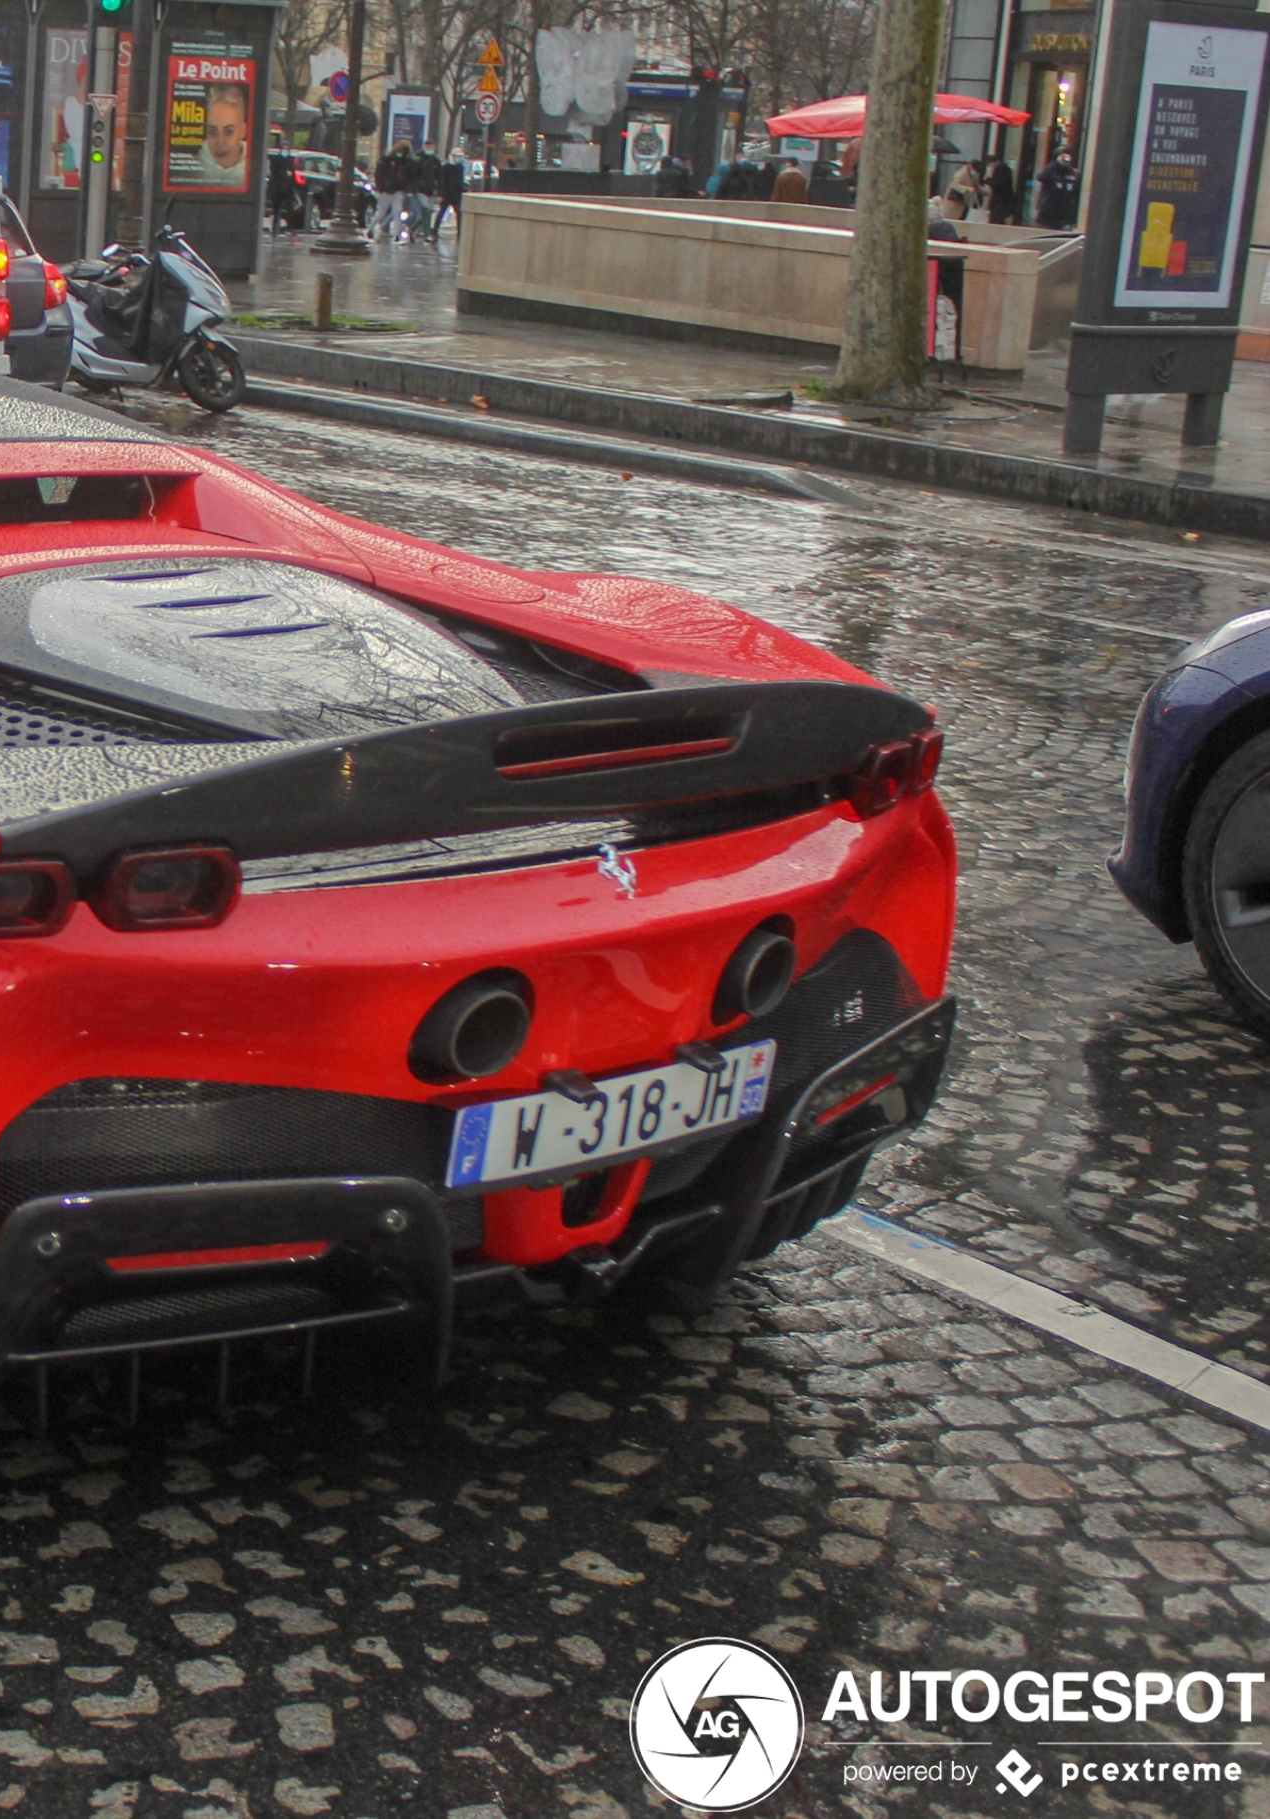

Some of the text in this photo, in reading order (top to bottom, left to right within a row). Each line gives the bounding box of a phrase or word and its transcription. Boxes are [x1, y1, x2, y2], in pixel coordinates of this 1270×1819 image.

[178, 60, 247, 81] Le Point
[1189, 64, 1216, 78] PARIS
[172, 101, 205, 123] Mila
[480, 101, 494, 115] 30
